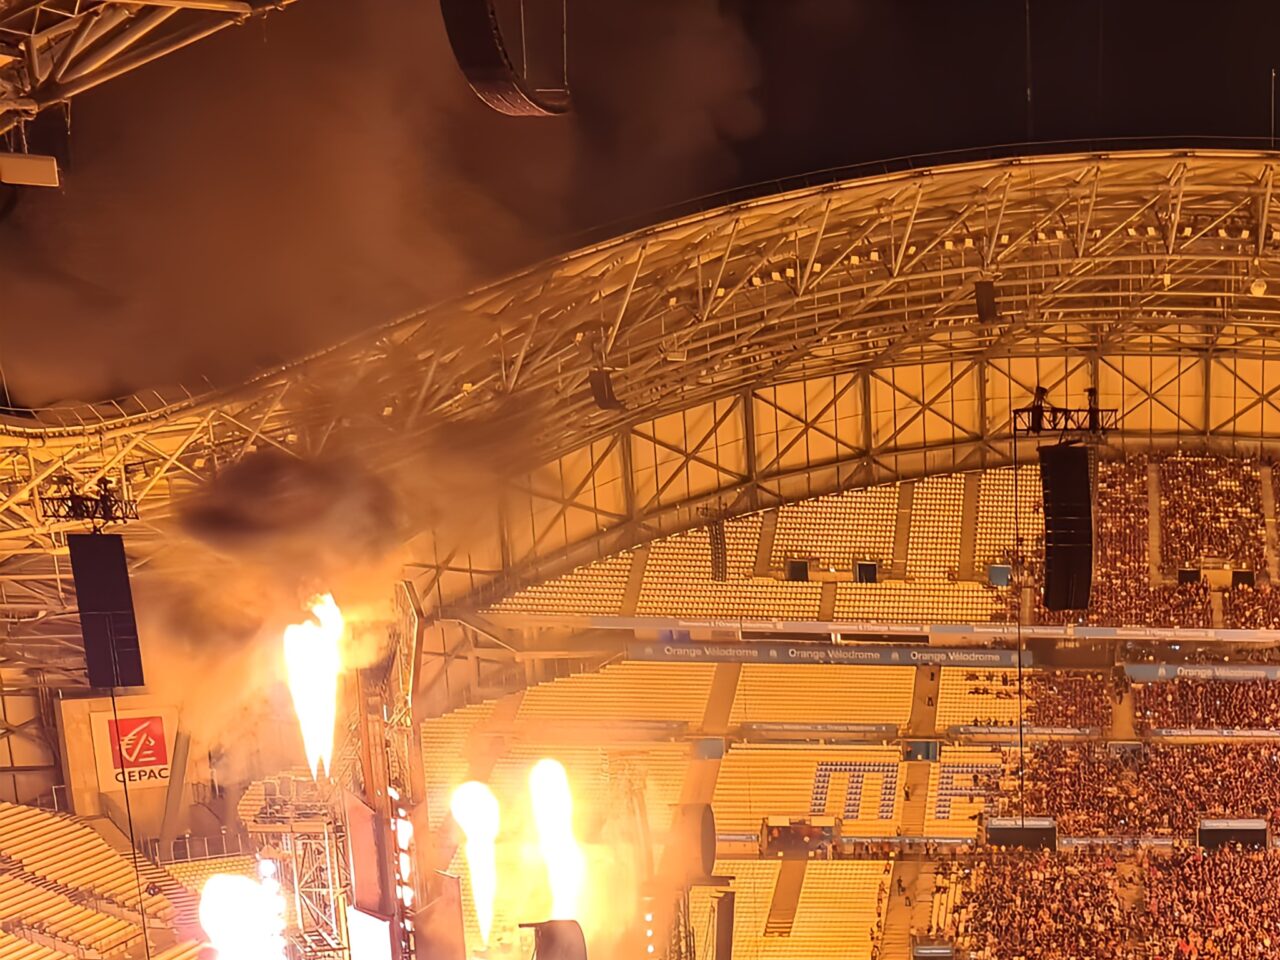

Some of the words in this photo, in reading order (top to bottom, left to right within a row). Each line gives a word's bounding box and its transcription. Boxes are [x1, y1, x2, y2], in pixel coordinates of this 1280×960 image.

[664, 646, 702, 657] Orange
[788, 648, 826, 659] Orange
[910, 651, 946, 662] Orange
[1176, 666, 1213, 678] Orange
[115, 768, 169, 783] CEPAC
